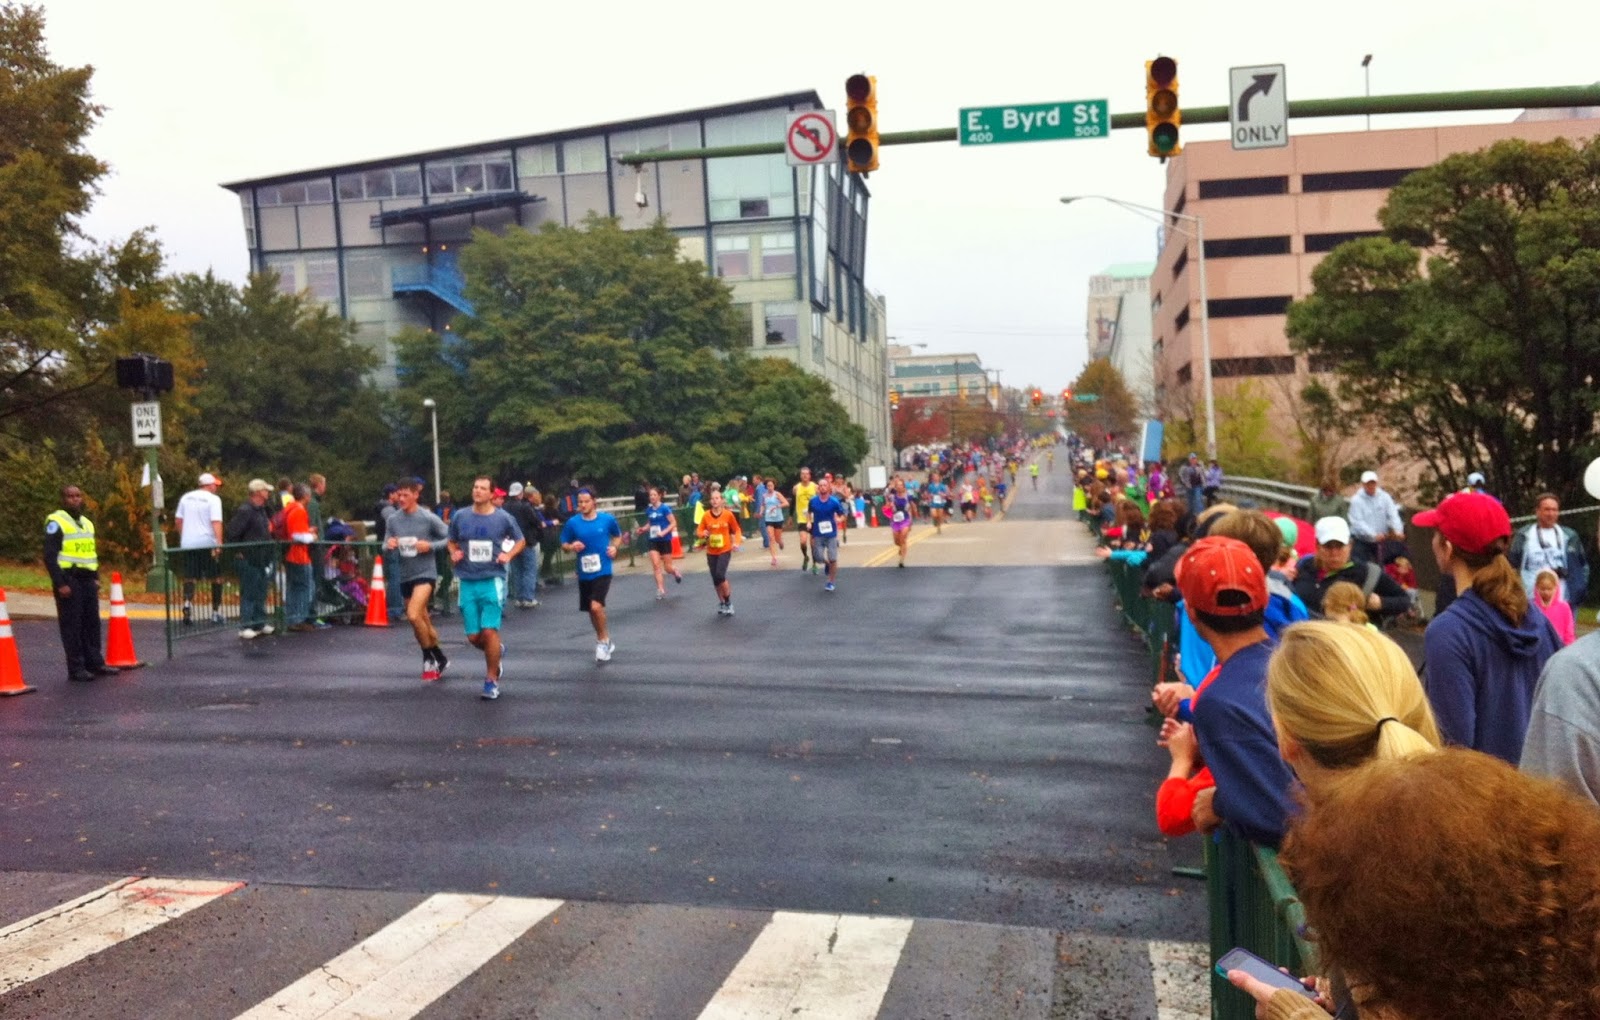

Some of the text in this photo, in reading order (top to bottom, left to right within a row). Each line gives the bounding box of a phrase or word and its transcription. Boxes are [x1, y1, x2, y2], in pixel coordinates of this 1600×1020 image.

[968, 104, 1100, 132] E. Byrd St
[968, 125, 1100, 143] 400 500
[1236, 124, 1282, 143] ONLY
[135, 406, 156, 417] ONE
[136, 418, 157, 429] WAY
